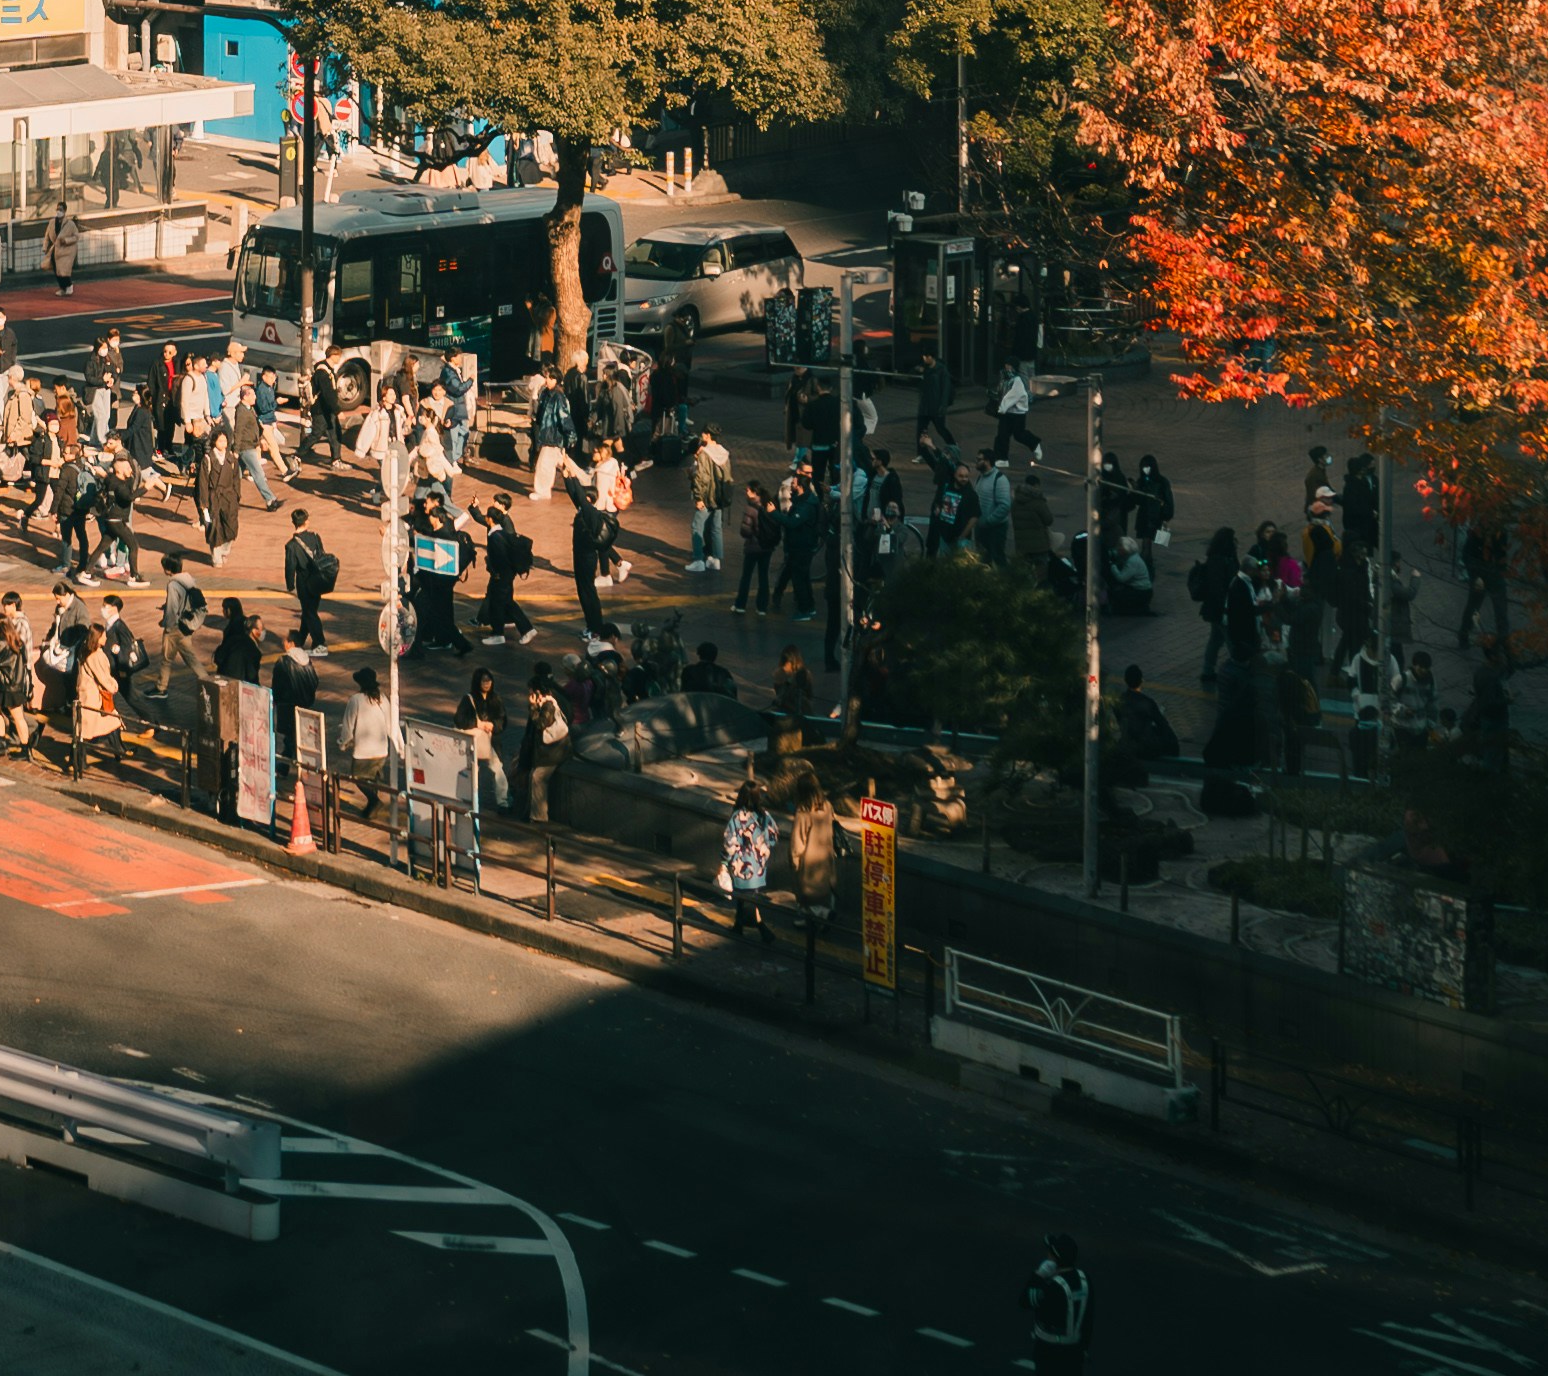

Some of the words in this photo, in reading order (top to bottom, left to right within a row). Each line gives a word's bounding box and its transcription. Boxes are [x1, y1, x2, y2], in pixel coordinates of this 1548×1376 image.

[430, 335, 466, 348] SHIBUYA
[862, 801, 894, 828] バス停
[863, 830, 887, 980] 駐停車禁止
